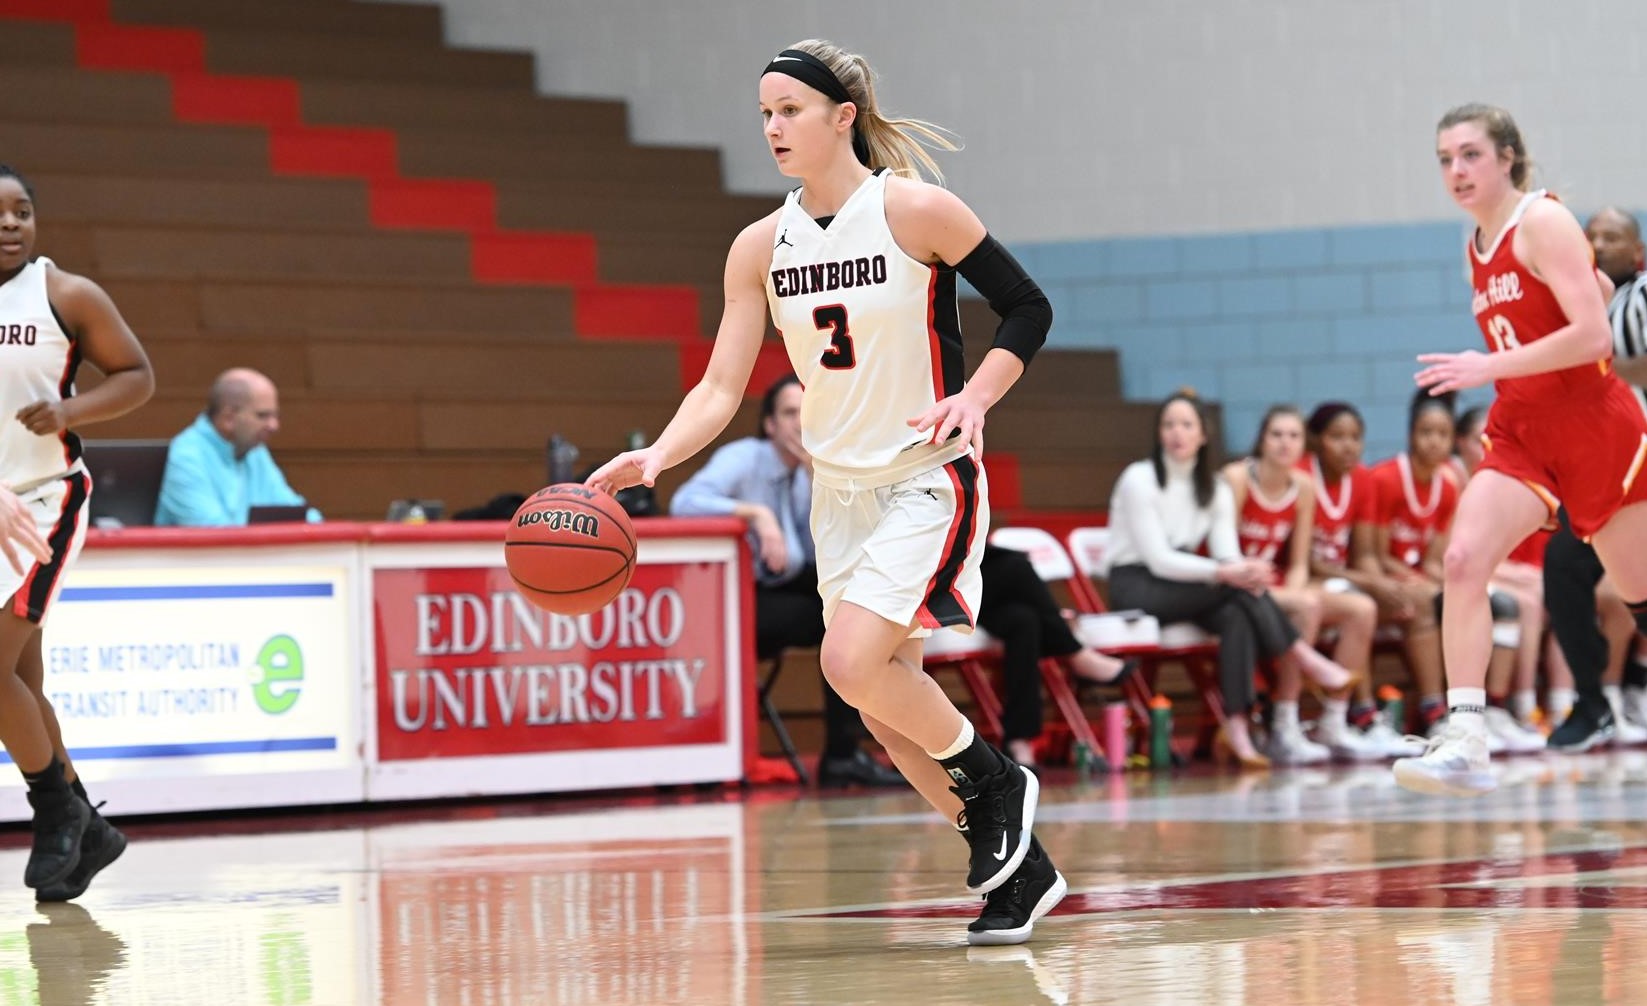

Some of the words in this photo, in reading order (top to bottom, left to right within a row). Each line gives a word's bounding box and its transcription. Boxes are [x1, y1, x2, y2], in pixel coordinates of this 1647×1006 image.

[771, 254, 887, 298] EDINBORO
[812, 303, 857, 370] 3
[517, 509, 599, 538] Wilson
[415, 587, 685, 656] EDINBORO
[50, 646, 89, 674] ERIE
[98, 642, 240, 673] METROPOLITAN
[52, 690, 128, 718] TRANSIT
[138, 687, 239, 717] AUTHORITY
[391, 659, 706, 732] UNIVERSITY
